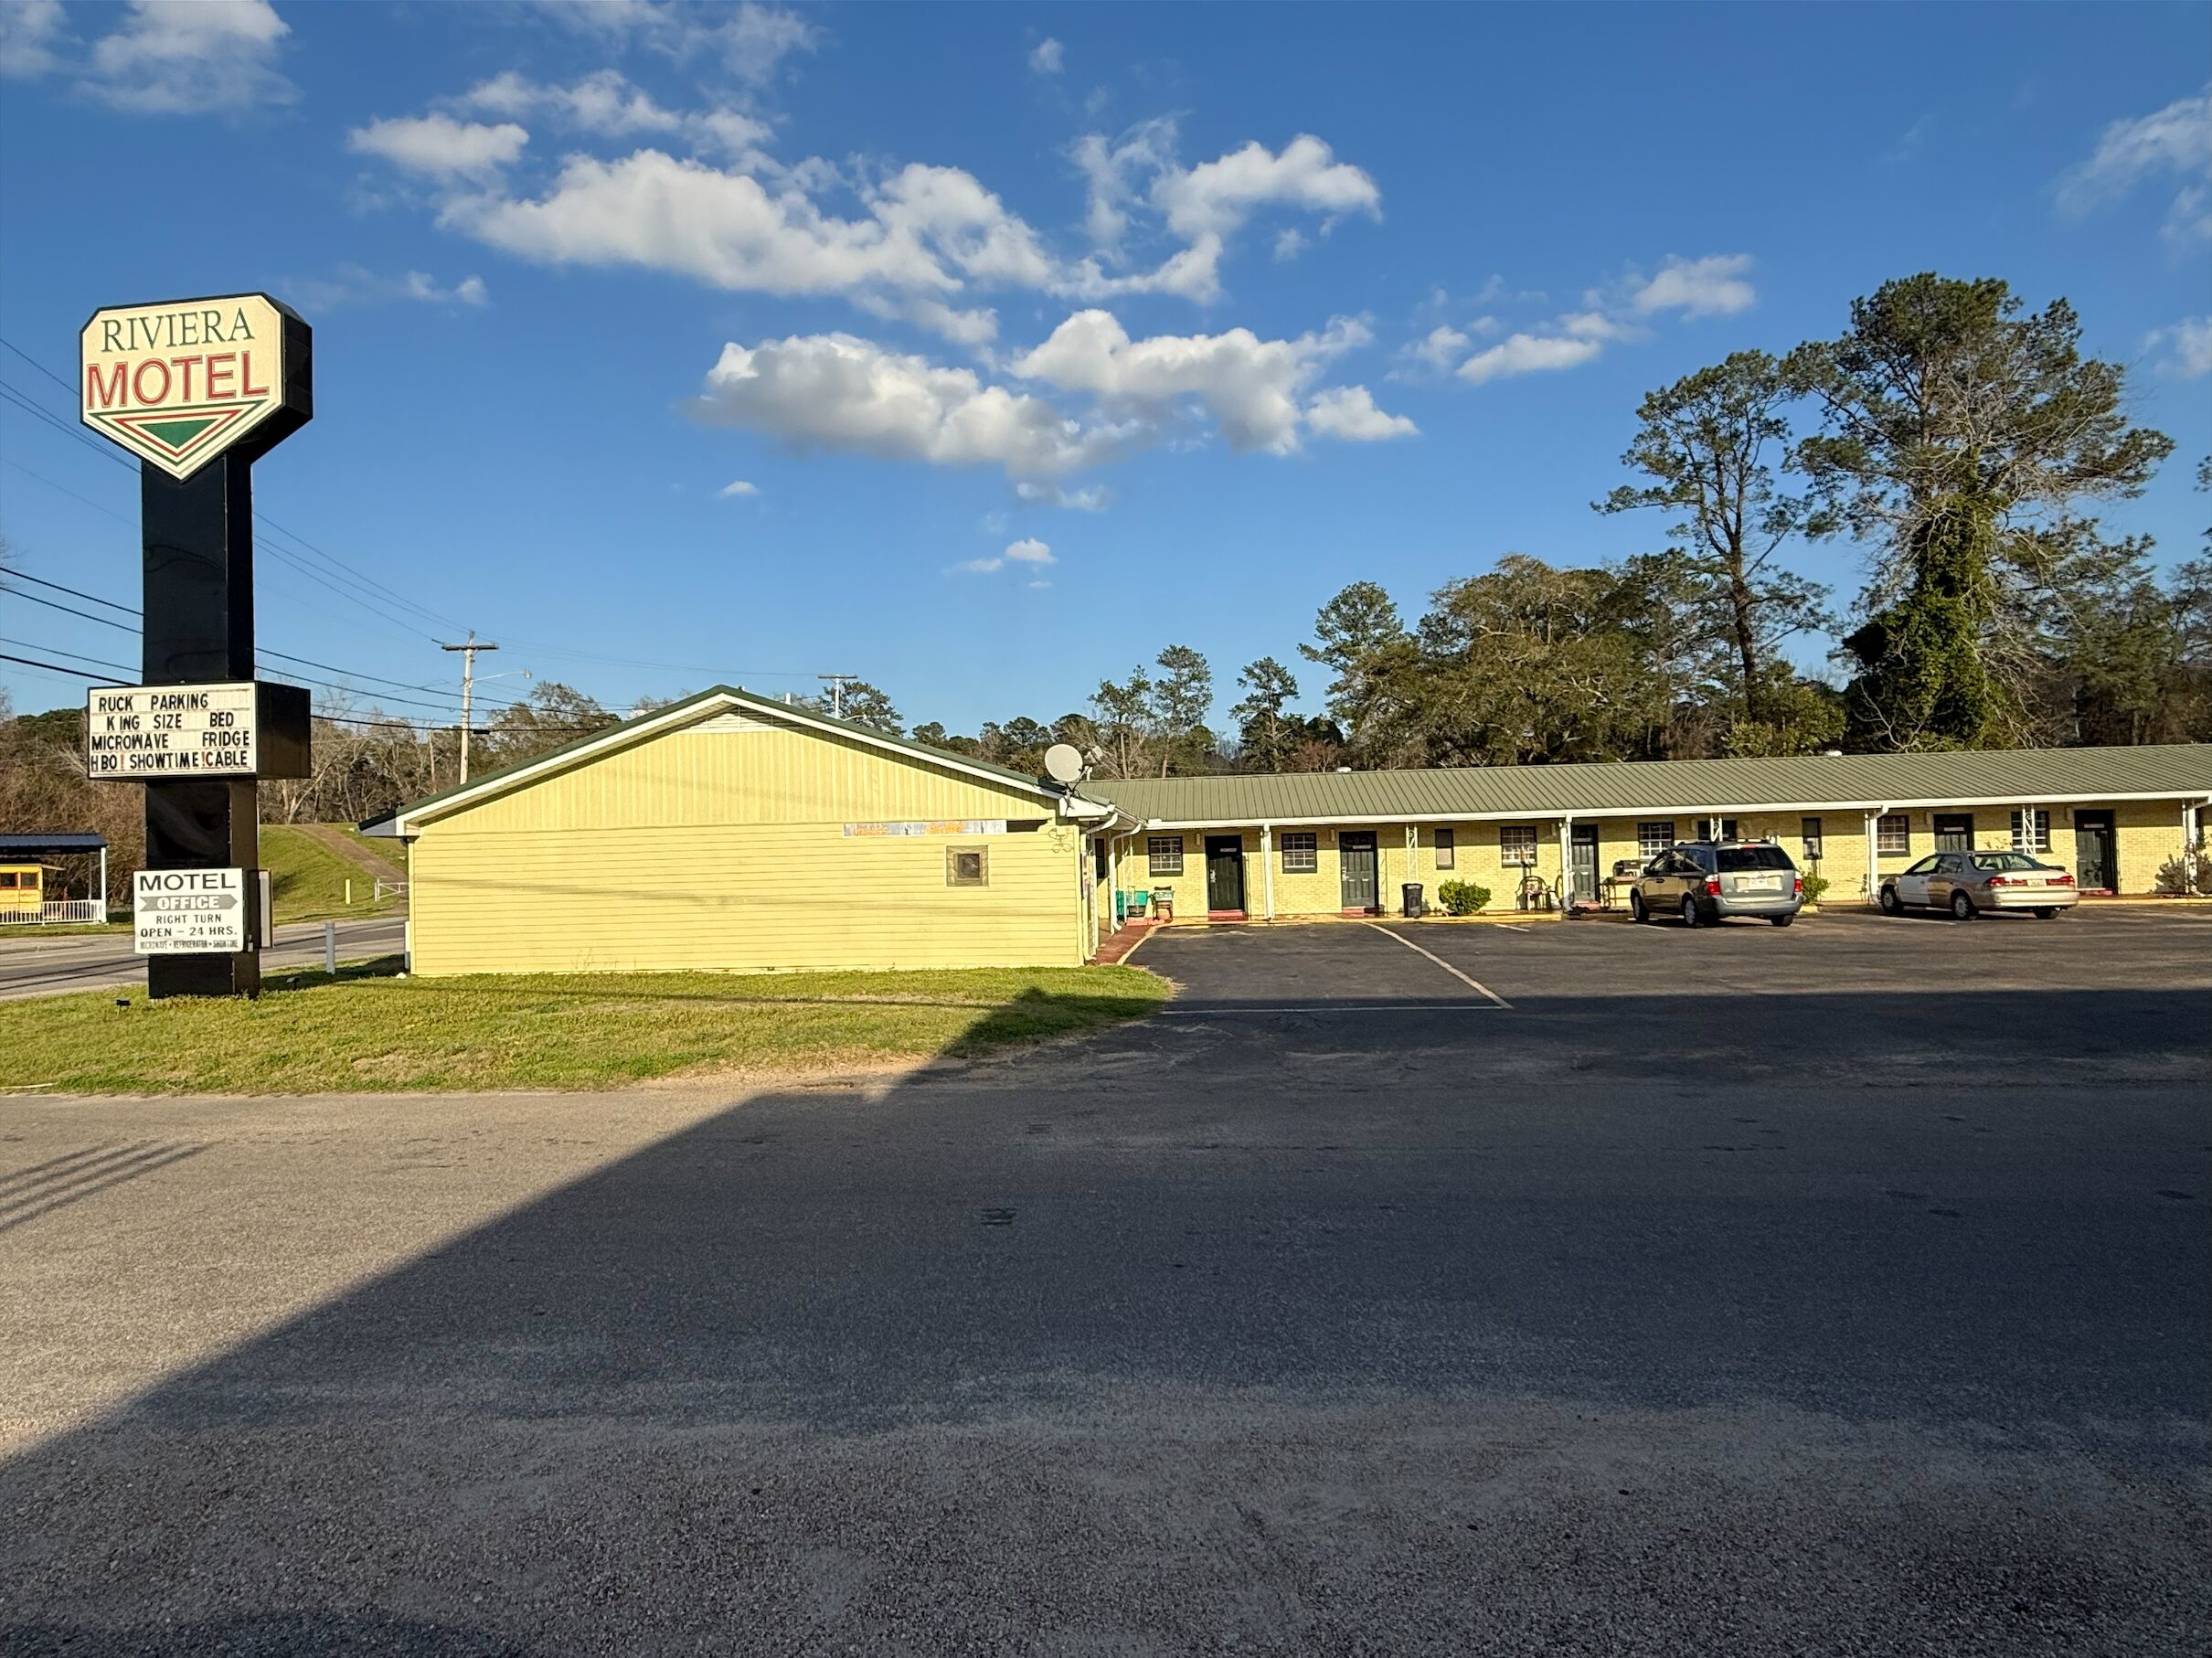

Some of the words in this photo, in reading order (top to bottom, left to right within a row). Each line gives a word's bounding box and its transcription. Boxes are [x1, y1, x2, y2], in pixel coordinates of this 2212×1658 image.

[101, 306, 255, 352] RIVIERA
[86, 350, 270, 409] MOTEL
[99, 696, 133, 712] RUCK
[150, 693, 208, 710] PARKING
[107, 715, 140, 731] KING
[154, 713, 182, 729] SIZE
[209, 712, 234, 728] BED
[91, 733, 169, 750] MICROWAVE
[202, 730, 250, 747] FRIDGE
[140, 873, 237, 891] MOTEL
[156, 896, 219, 910] OFFICE
[156, 914, 187, 924] RIGHT
[194, 914, 222, 923] TURN
[140, 928, 172, 938] OPEN
[189, 927, 204, 936] 24
[209, 926, 238, 936] HRS.
